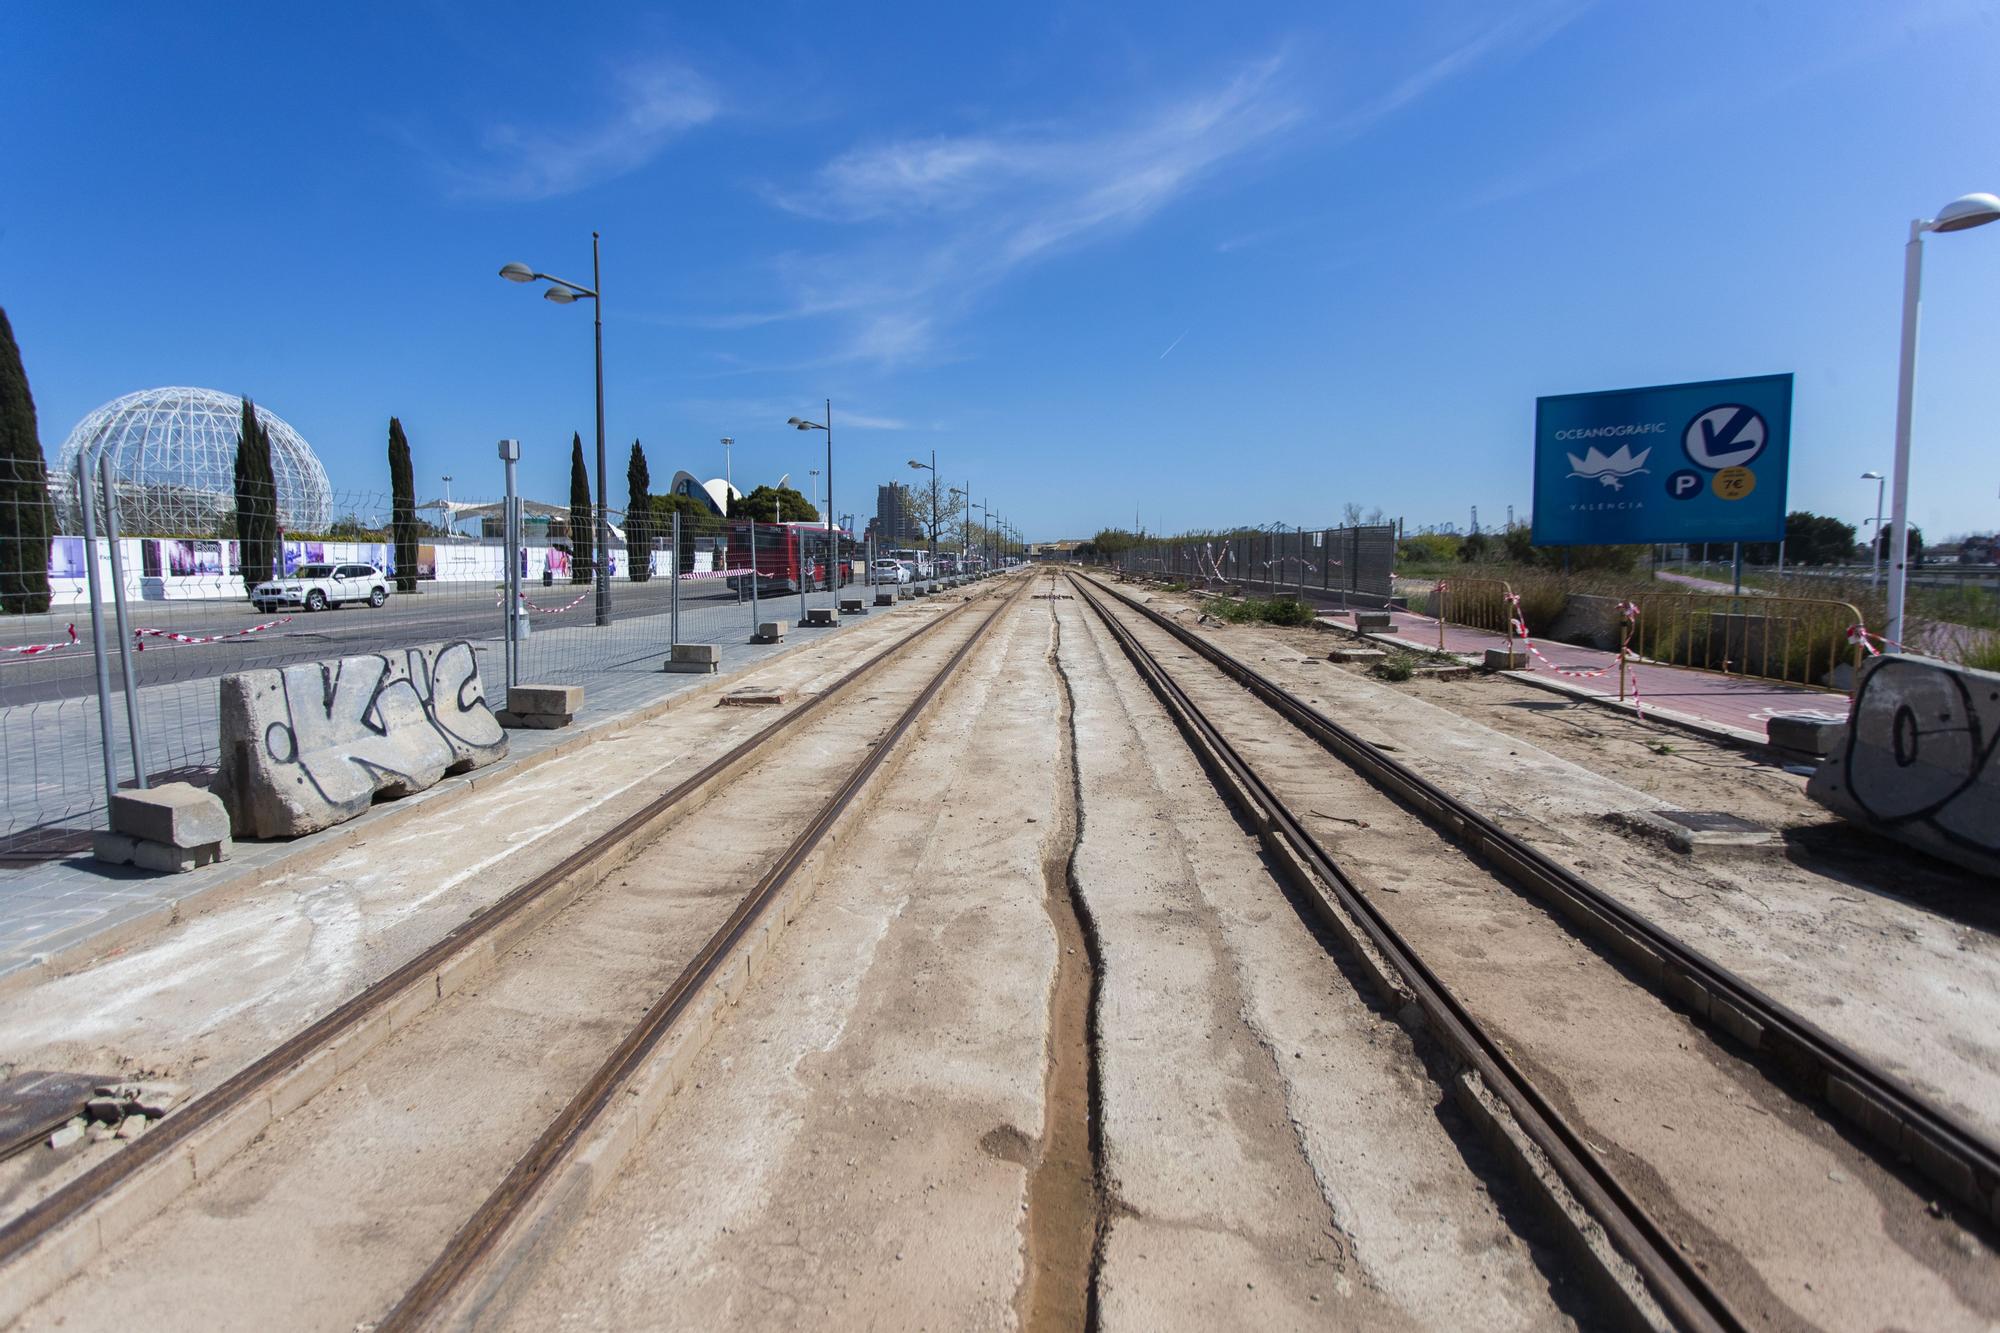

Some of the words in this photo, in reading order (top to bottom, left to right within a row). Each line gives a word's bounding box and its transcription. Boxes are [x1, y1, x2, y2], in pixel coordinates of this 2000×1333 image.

[1675, 475, 1697, 496] P
[1723, 479, 1744, 490] 7€
[1569, 501, 1644, 512] VALENCIA
